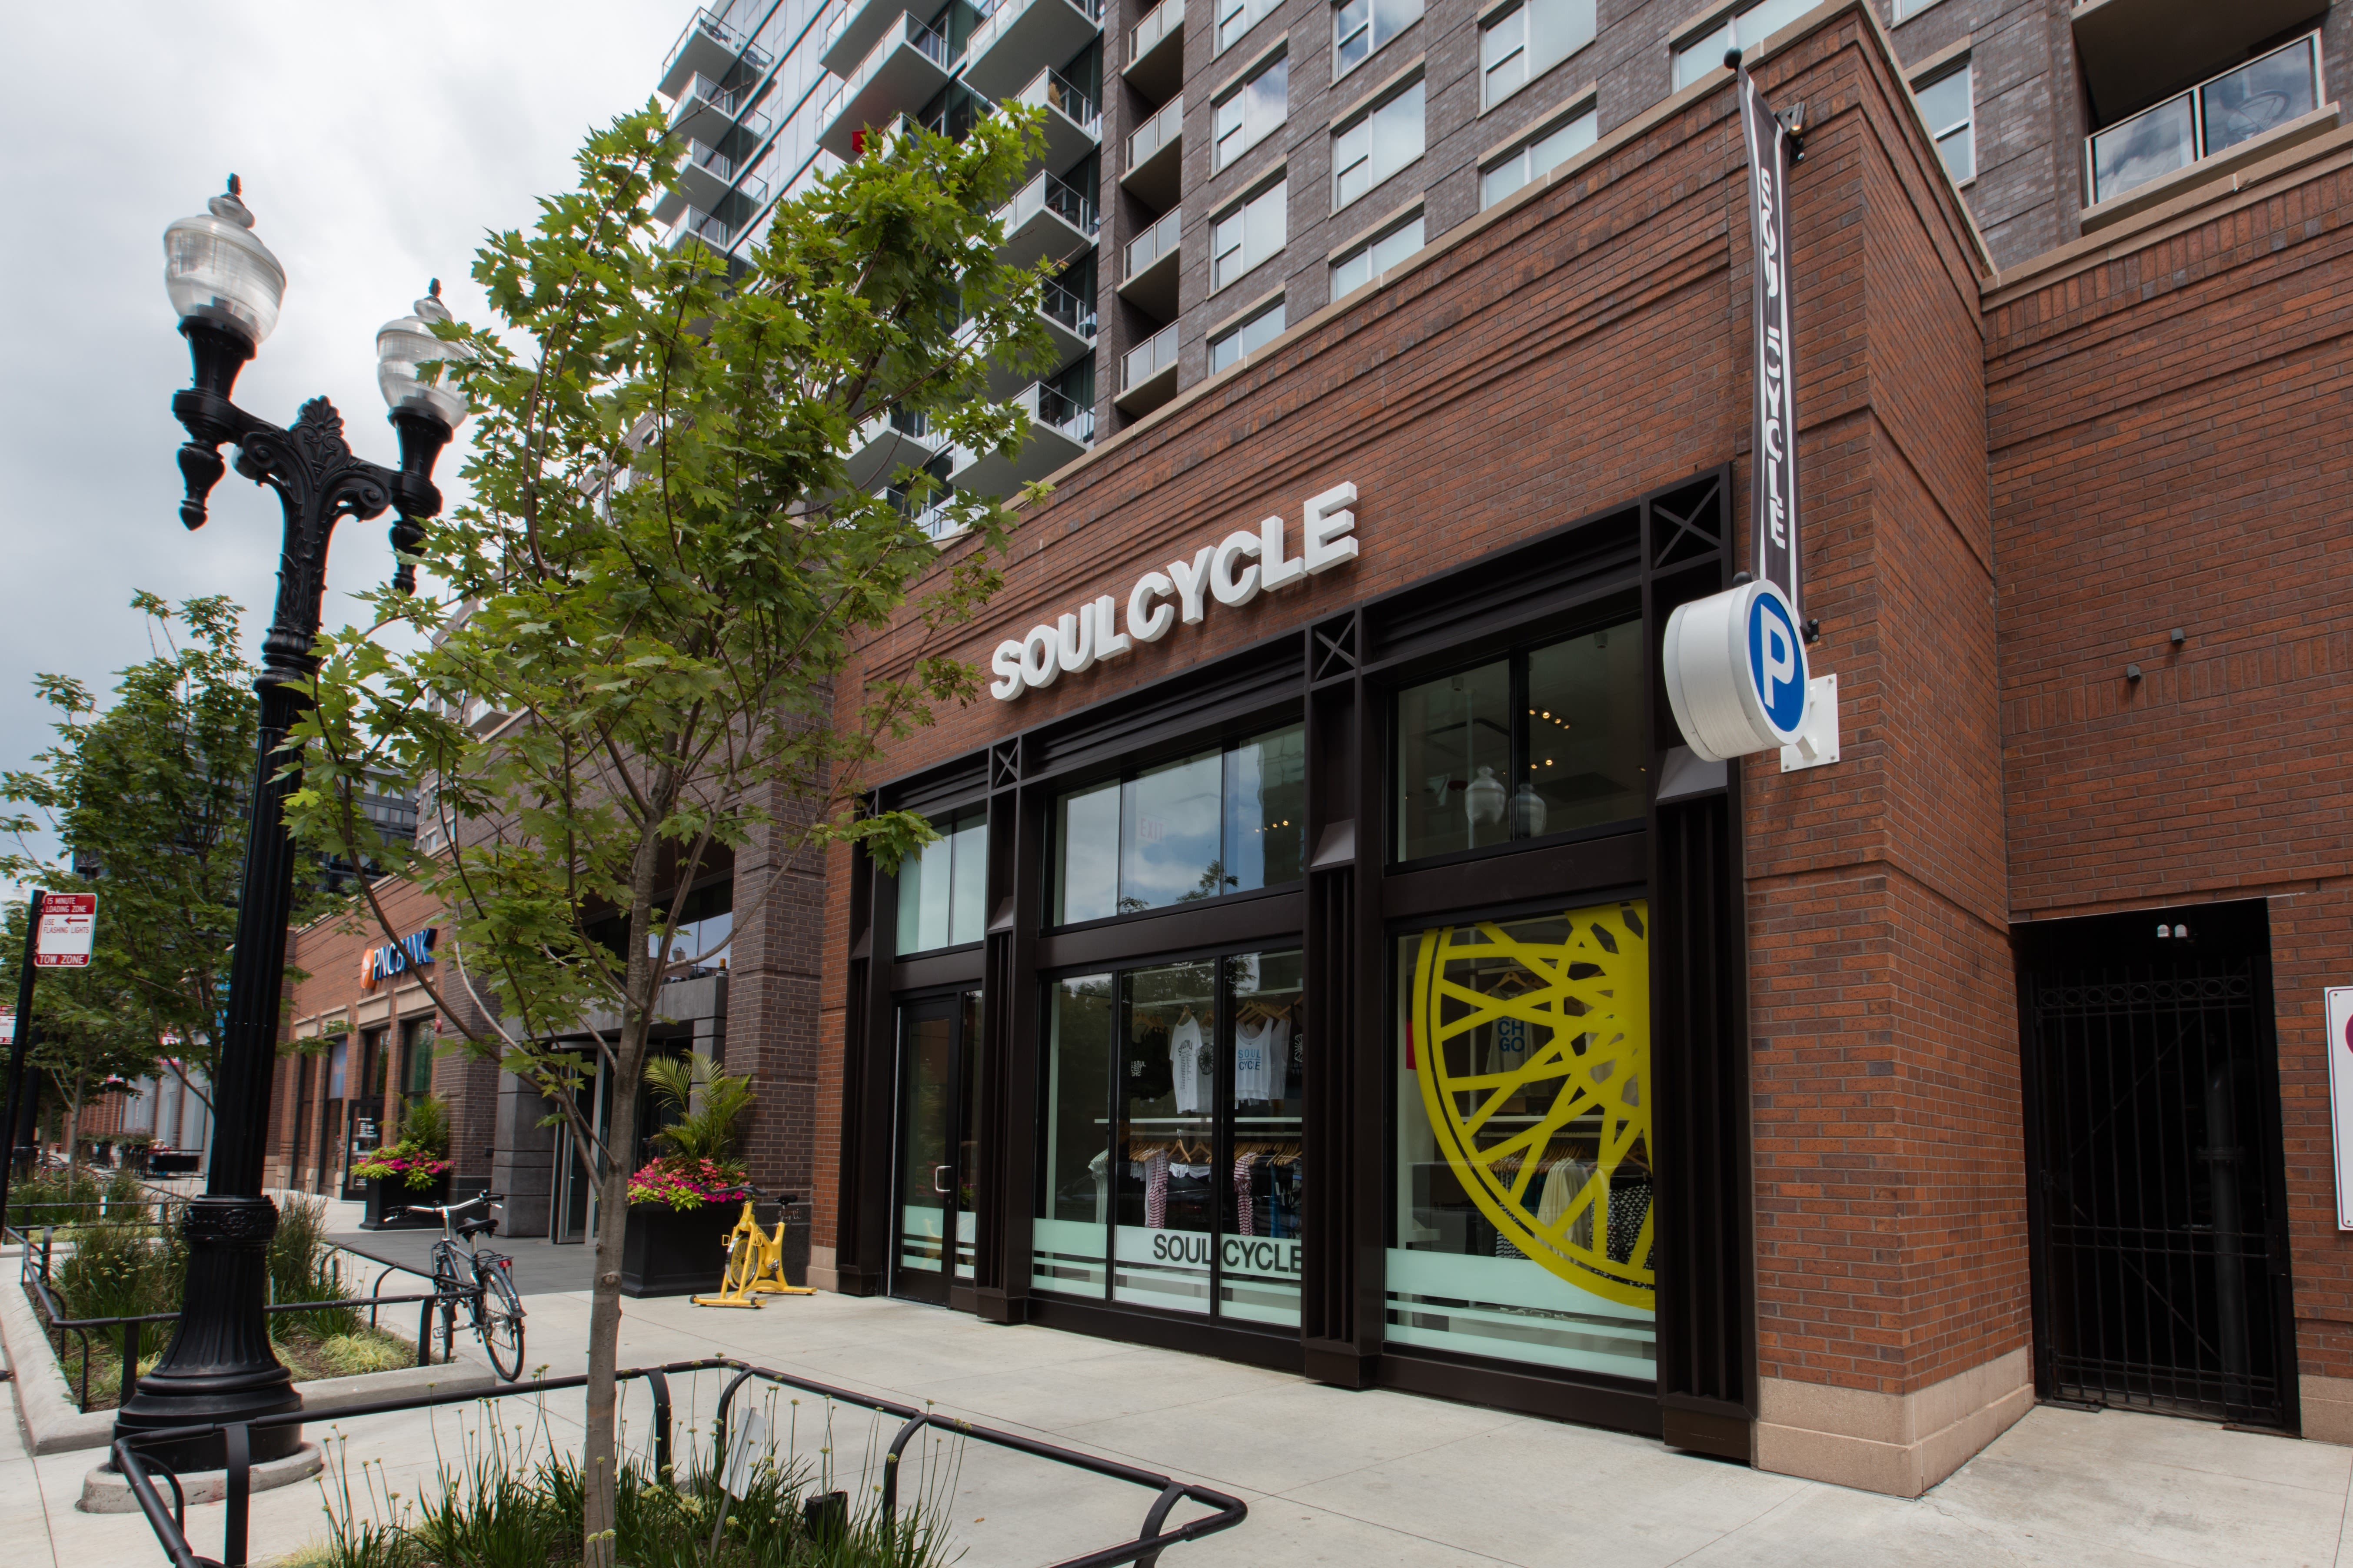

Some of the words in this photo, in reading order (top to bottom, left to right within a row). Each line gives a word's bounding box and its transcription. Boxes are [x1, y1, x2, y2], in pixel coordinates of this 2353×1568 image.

[1761, 167, 1786, 550] SOULCYCLE
[990, 480, 1358, 702] SOULCYCLE
[1761, 603, 1794, 709] P
[1141, 817, 1163, 842] EXIT
[40, 955, 57, 964] TOW
[61, 955, 85, 964] ZONE
[1238, 1049, 1261, 1058] SOUL
